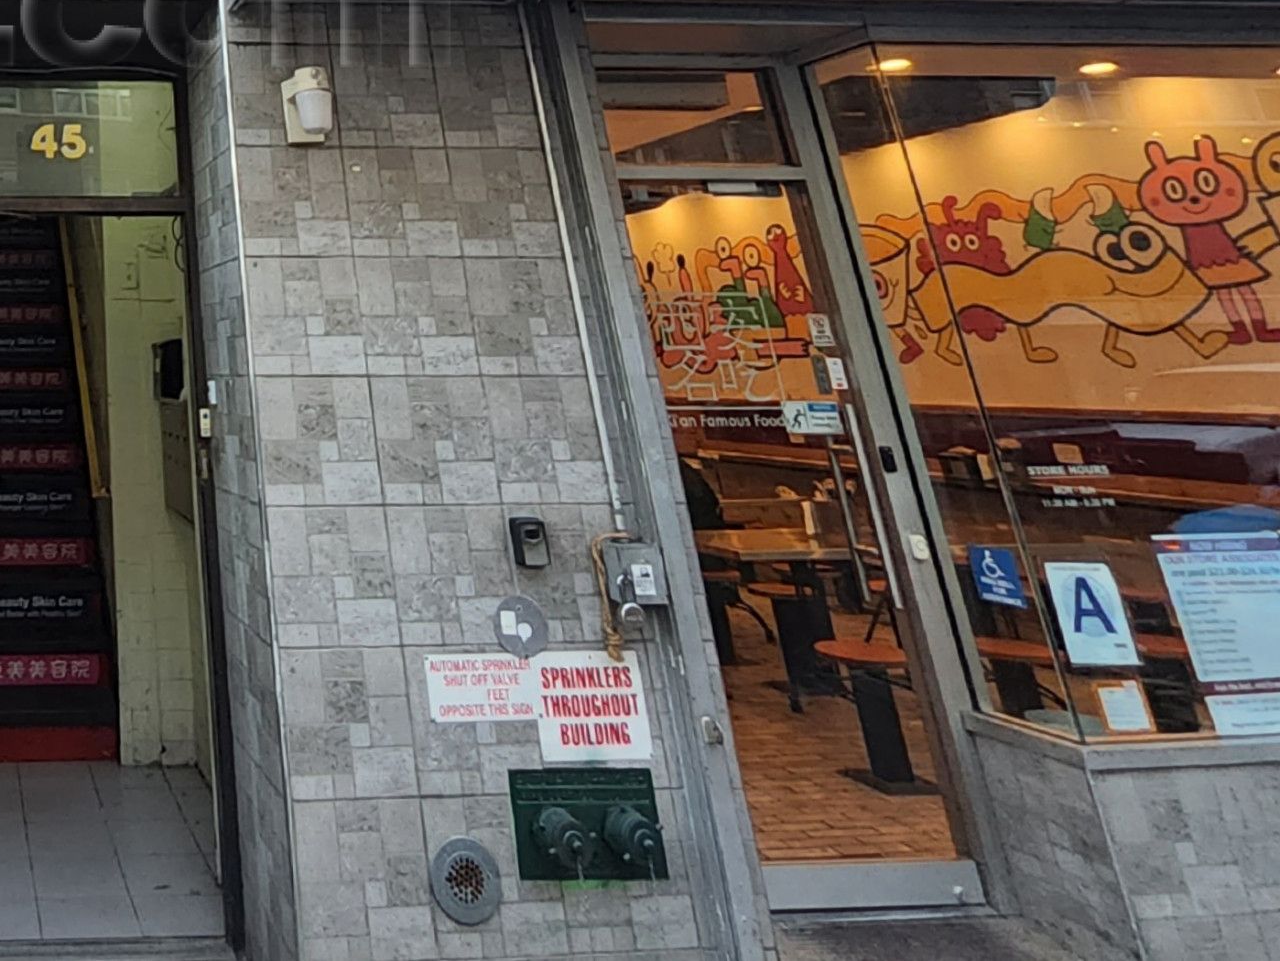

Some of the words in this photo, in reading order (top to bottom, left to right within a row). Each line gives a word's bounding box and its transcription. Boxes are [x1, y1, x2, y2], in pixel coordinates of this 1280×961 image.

[29, 123, 88, 159] 45
[700, 413, 751, 428] Famous
[1073, 576, 1118, 634] A
[429, 659, 480, 673] AUTOMATIC
[481, 658, 531, 671] SPRINKLER
[443, 673, 468, 687] SHUT
[470, 673, 489, 686] OFF
[490, 673, 521, 686] VALVE
[540, 666, 633, 690] SPRINKLERS
[487, 688, 510, 701] FEET
[438, 703, 486, 717] OPPOSITE
[487, 703, 510, 716] THIS
[511, 702, 535, 715] SIGN
[540, 693, 639, 718] THROUGHOUT
[559, 721, 632, 746] BUILDING
